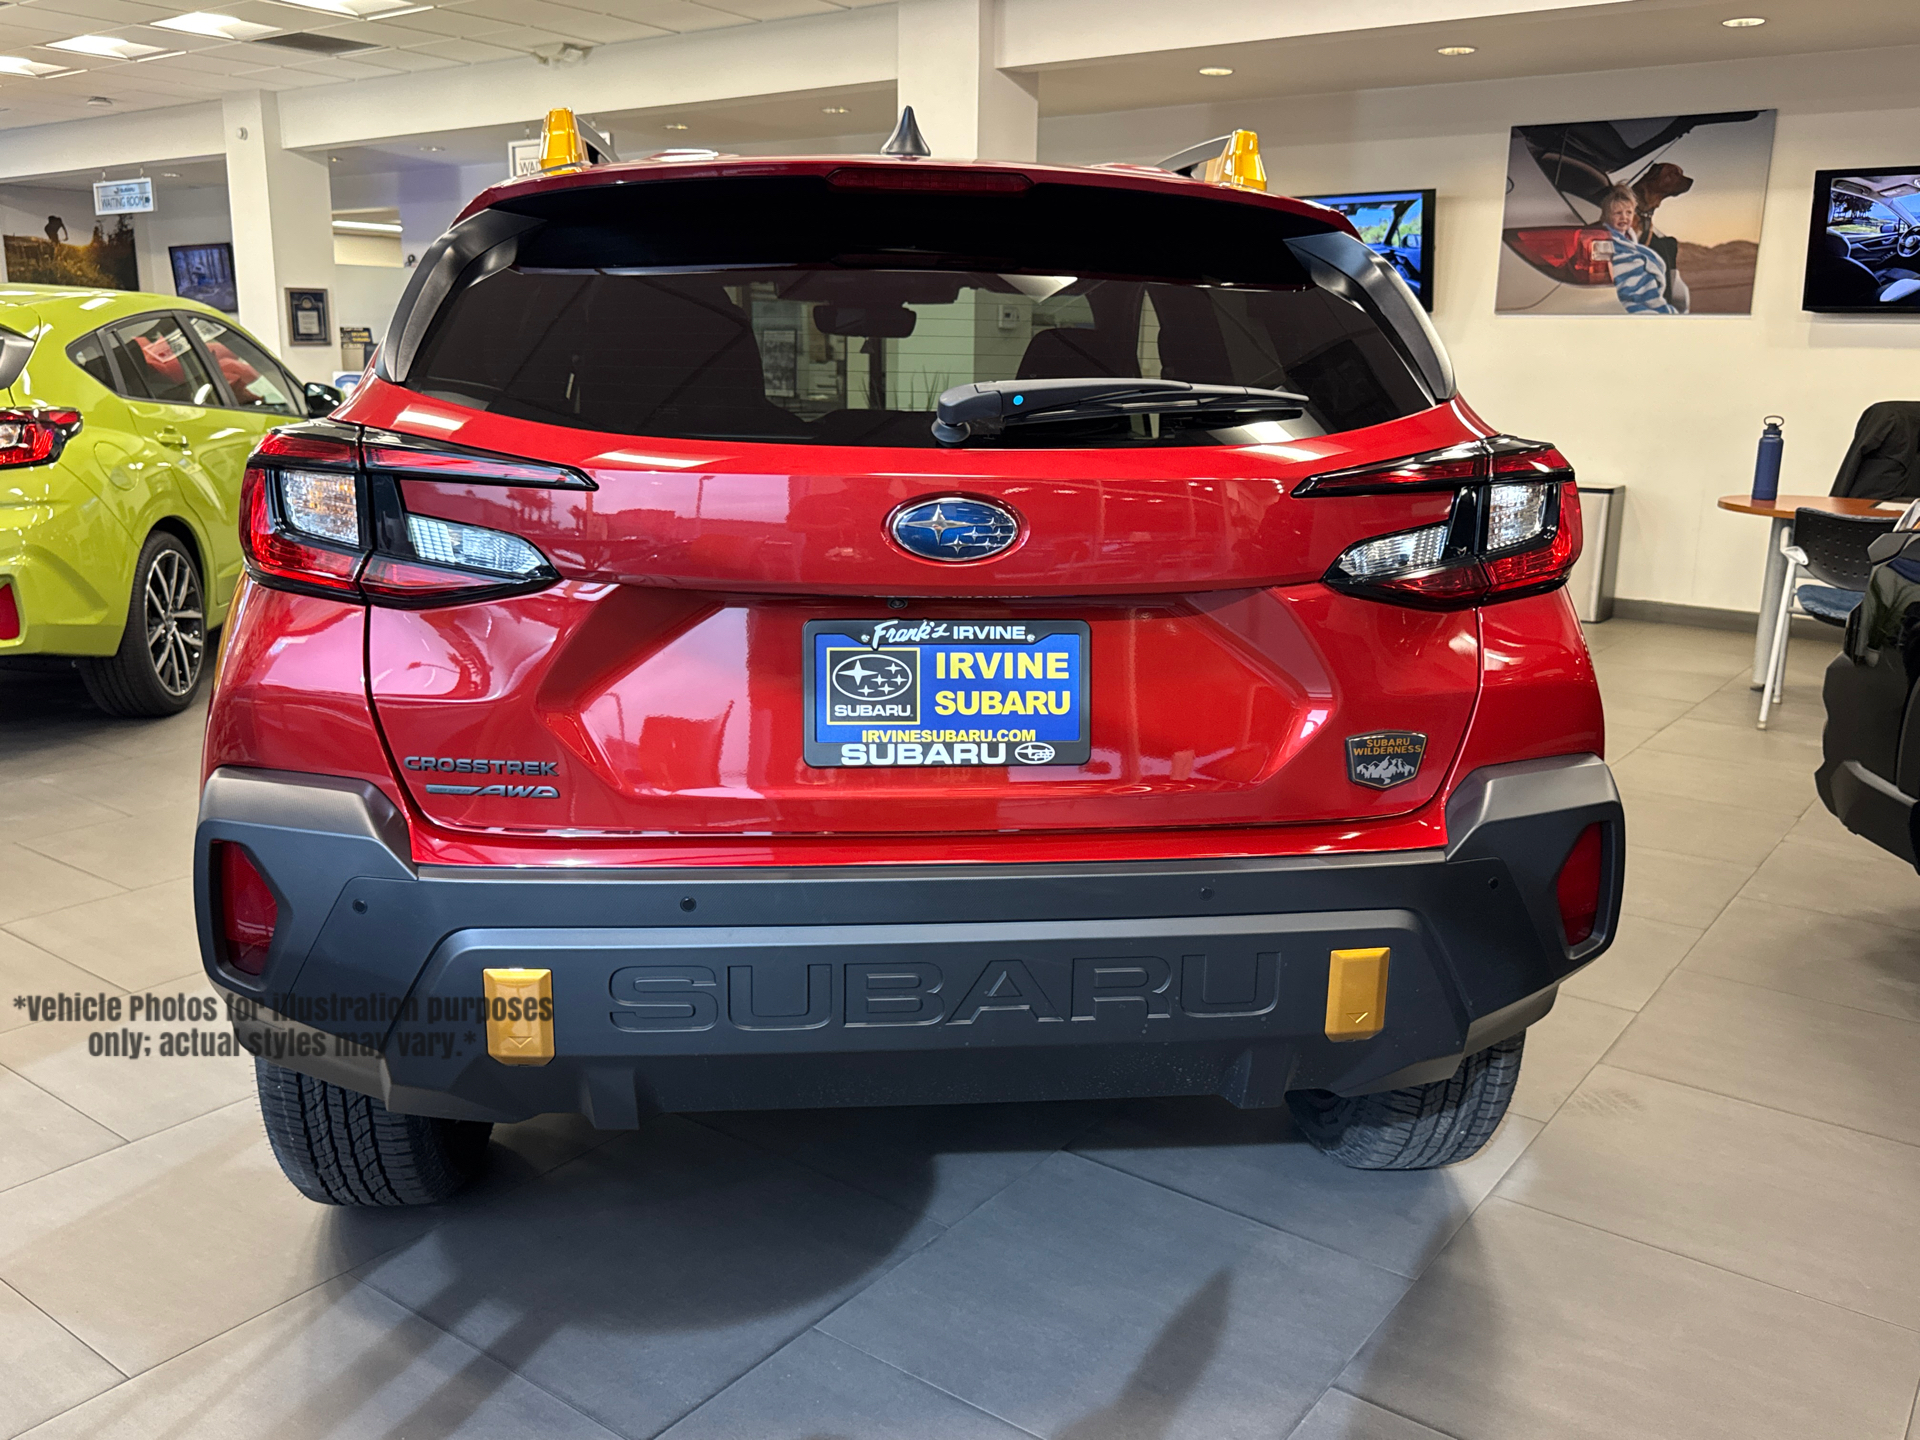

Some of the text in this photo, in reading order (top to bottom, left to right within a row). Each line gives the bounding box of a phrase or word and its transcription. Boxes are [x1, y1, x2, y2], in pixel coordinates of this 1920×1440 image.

[102, 196, 126, 208] WAITING
[872, 619, 1026, 649] Frank's IRVINE
[935, 652, 1070, 679] IRVINE
[834, 704, 911, 717] SUBARU
[934, 690, 1071, 715] SUBARU
[862, 729, 1036, 743] IRVINESUBARU.COM
[1366, 738, 1410, 747] SUBARU
[840, 743, 1007, 766] SUBARU
[1353, 745, 1421, 755] WILDERNESS
[403, 756, 559, 776] CROSSTREK
[474, 784, 559, 798] AWD
[608, 951, 1281, 1034] SUBARU
